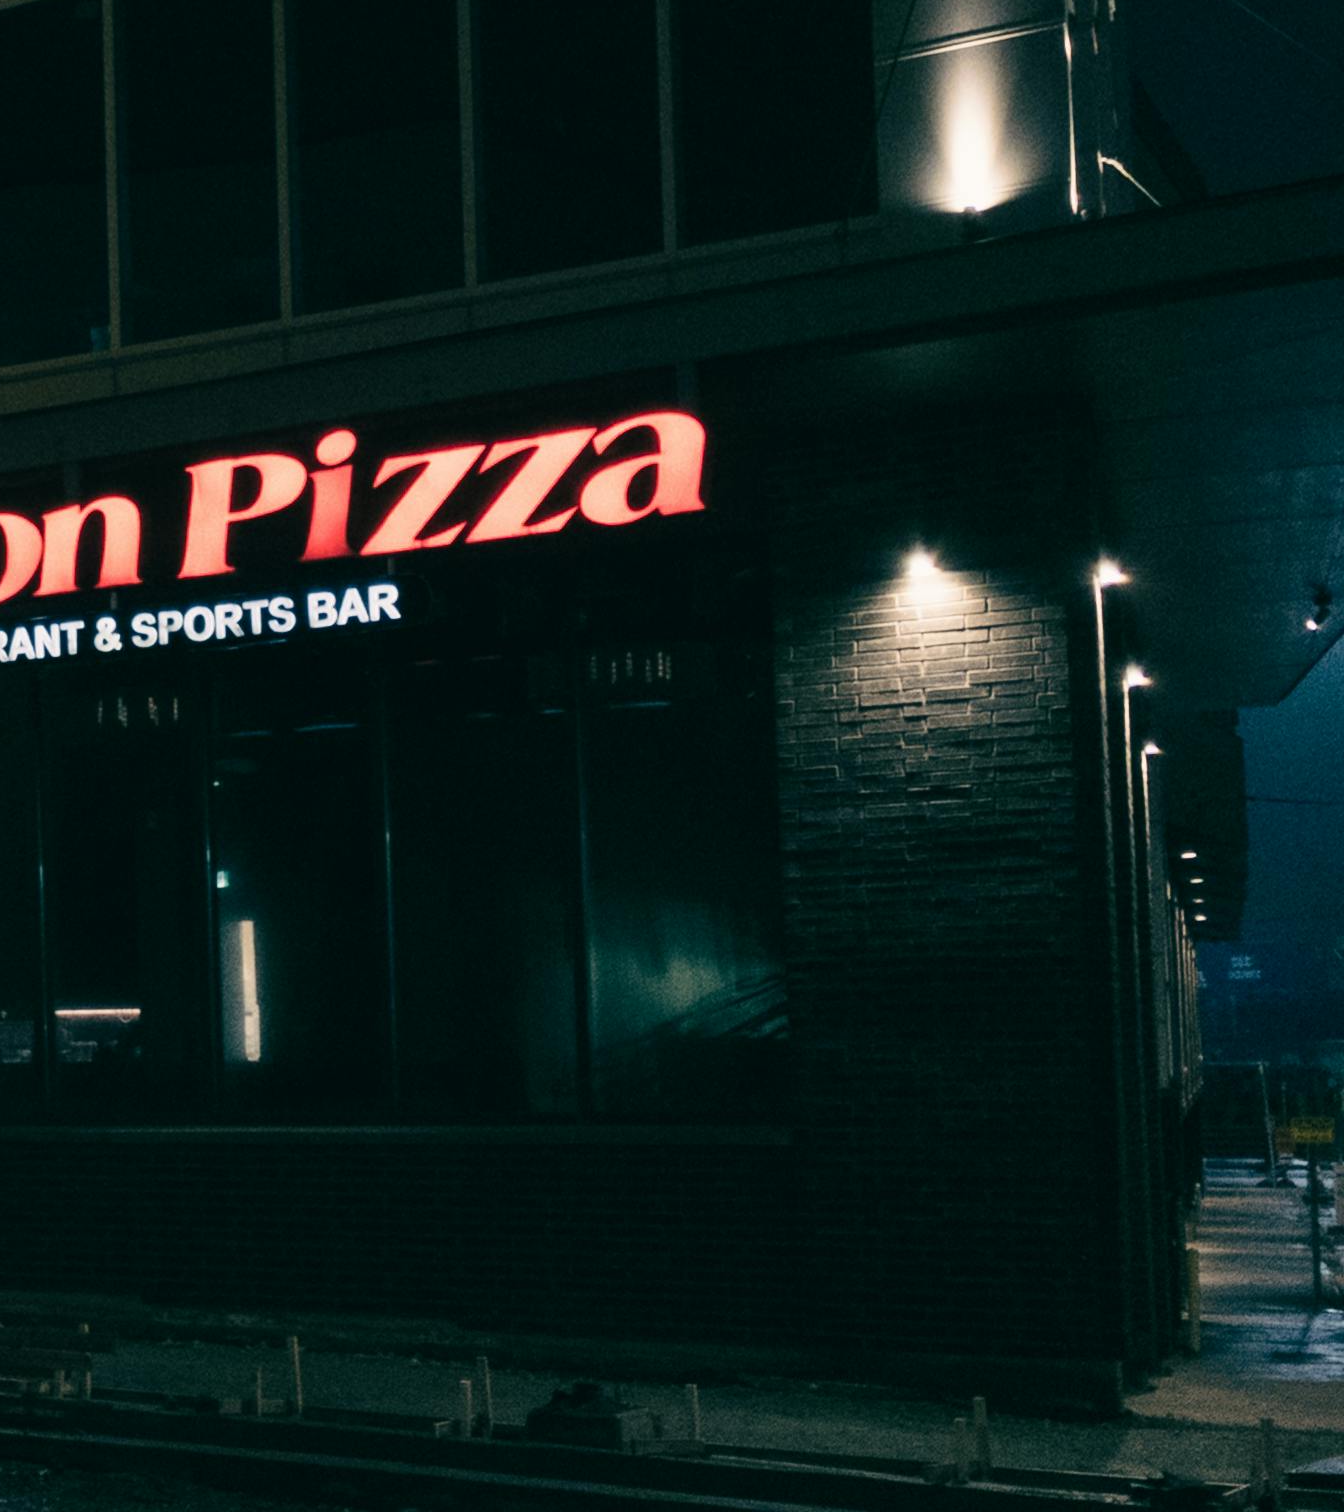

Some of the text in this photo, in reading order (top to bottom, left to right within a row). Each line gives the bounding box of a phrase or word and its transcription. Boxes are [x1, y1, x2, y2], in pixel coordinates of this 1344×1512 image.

[177, 410, 707, 580] Pizza
[93, 616, 123, 653] &
[131, 596, 297, 648] SPORTS
[307, 584, 402, 629] BAR
